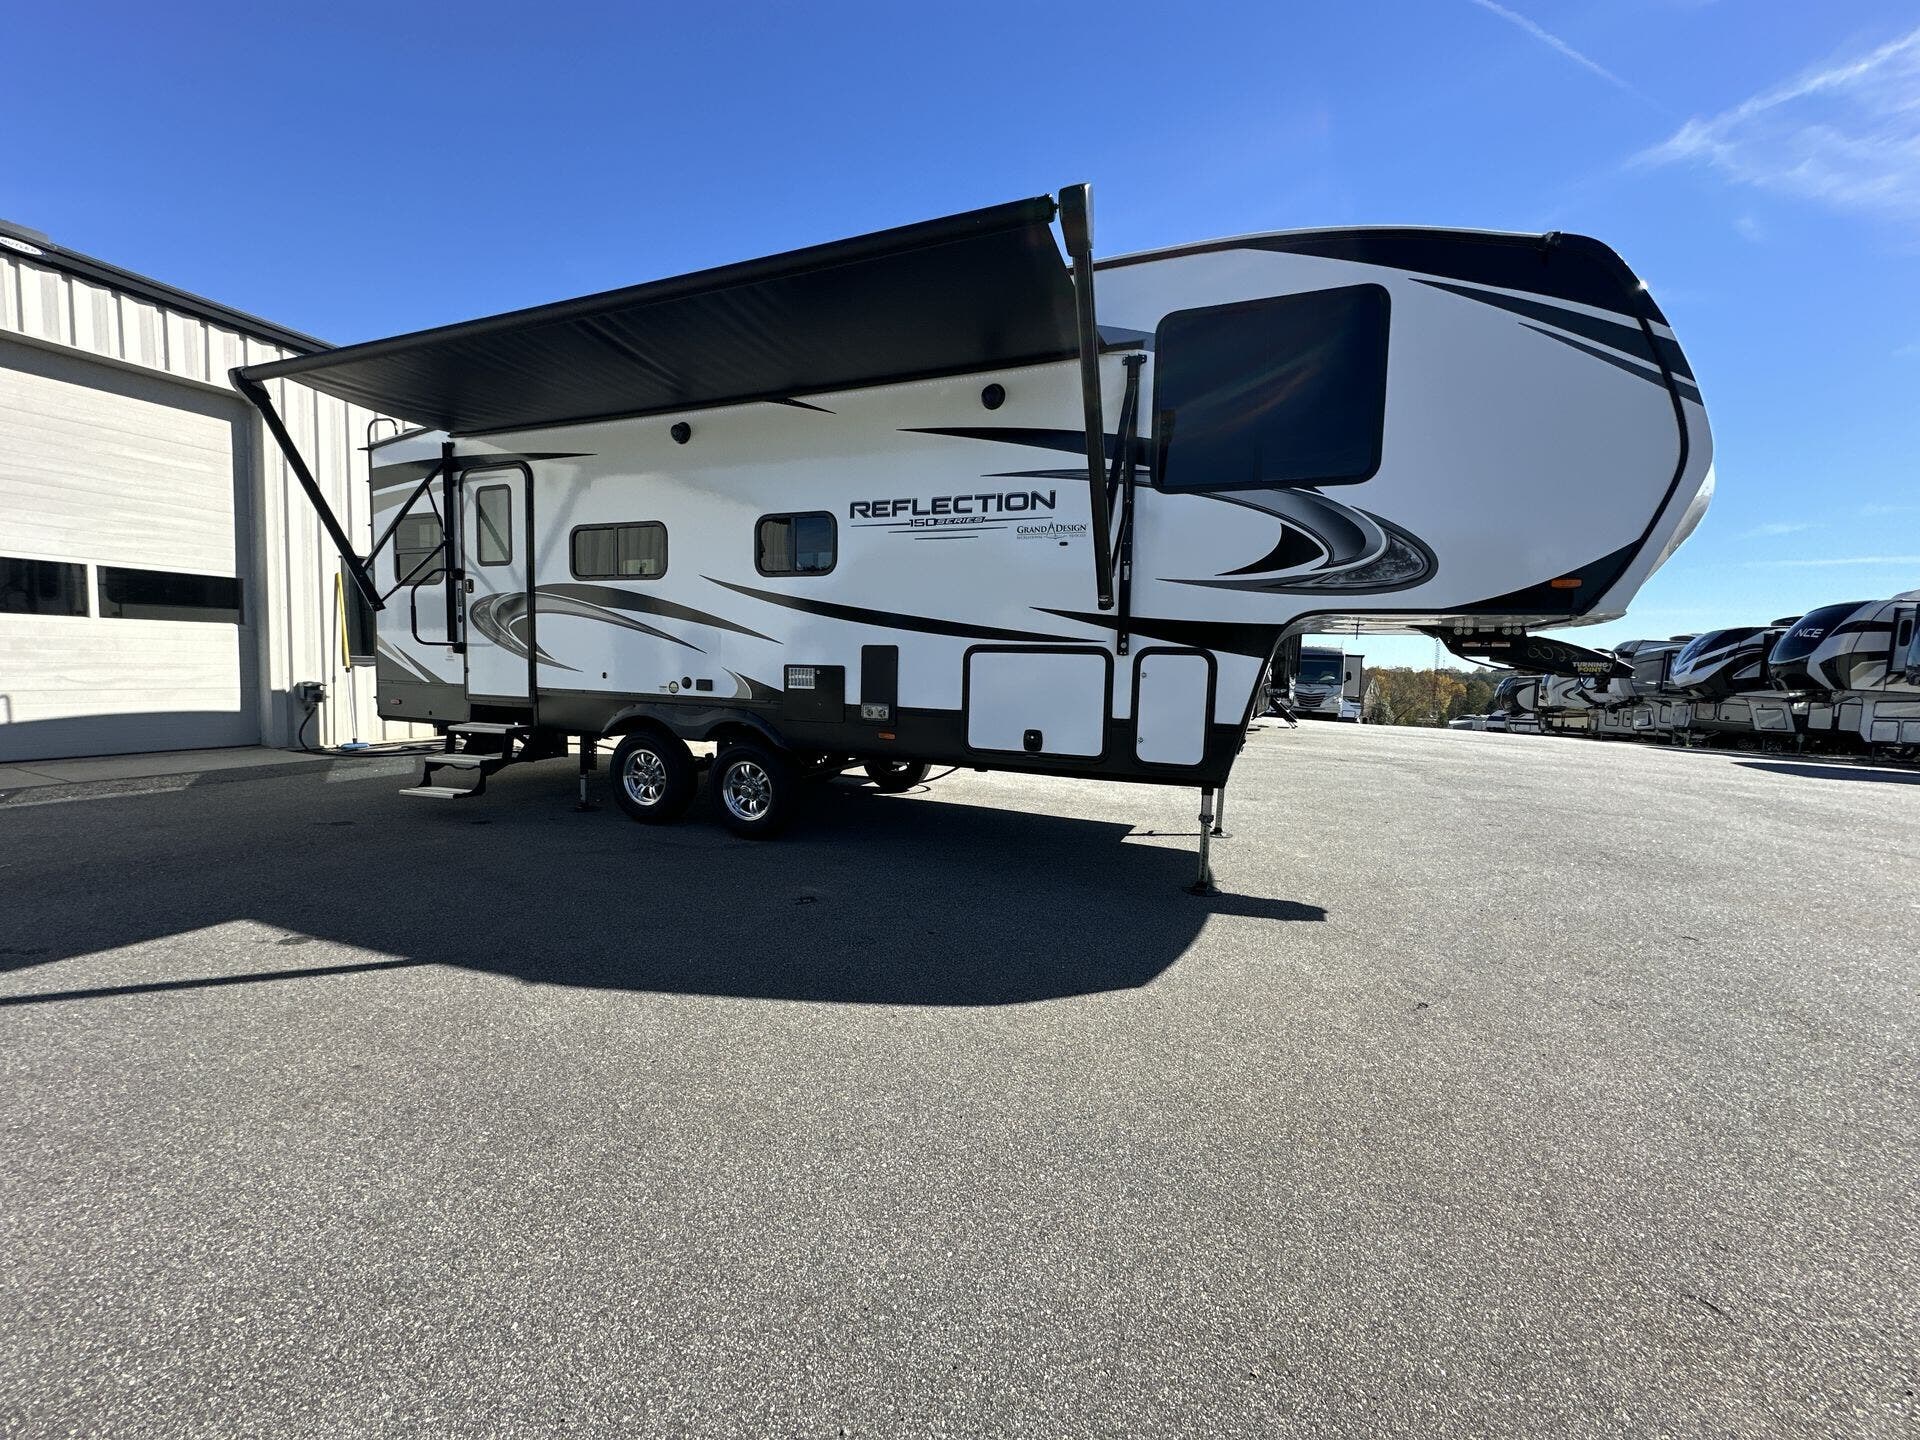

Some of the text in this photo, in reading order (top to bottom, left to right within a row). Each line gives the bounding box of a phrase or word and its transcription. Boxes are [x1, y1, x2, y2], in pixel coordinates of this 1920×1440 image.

[850, 490, 1056, 519] REFLECTION
[909, 516, 985, 527] 150 SERIES
[1016, 524, 1087, 534] GRAND DESIGN
